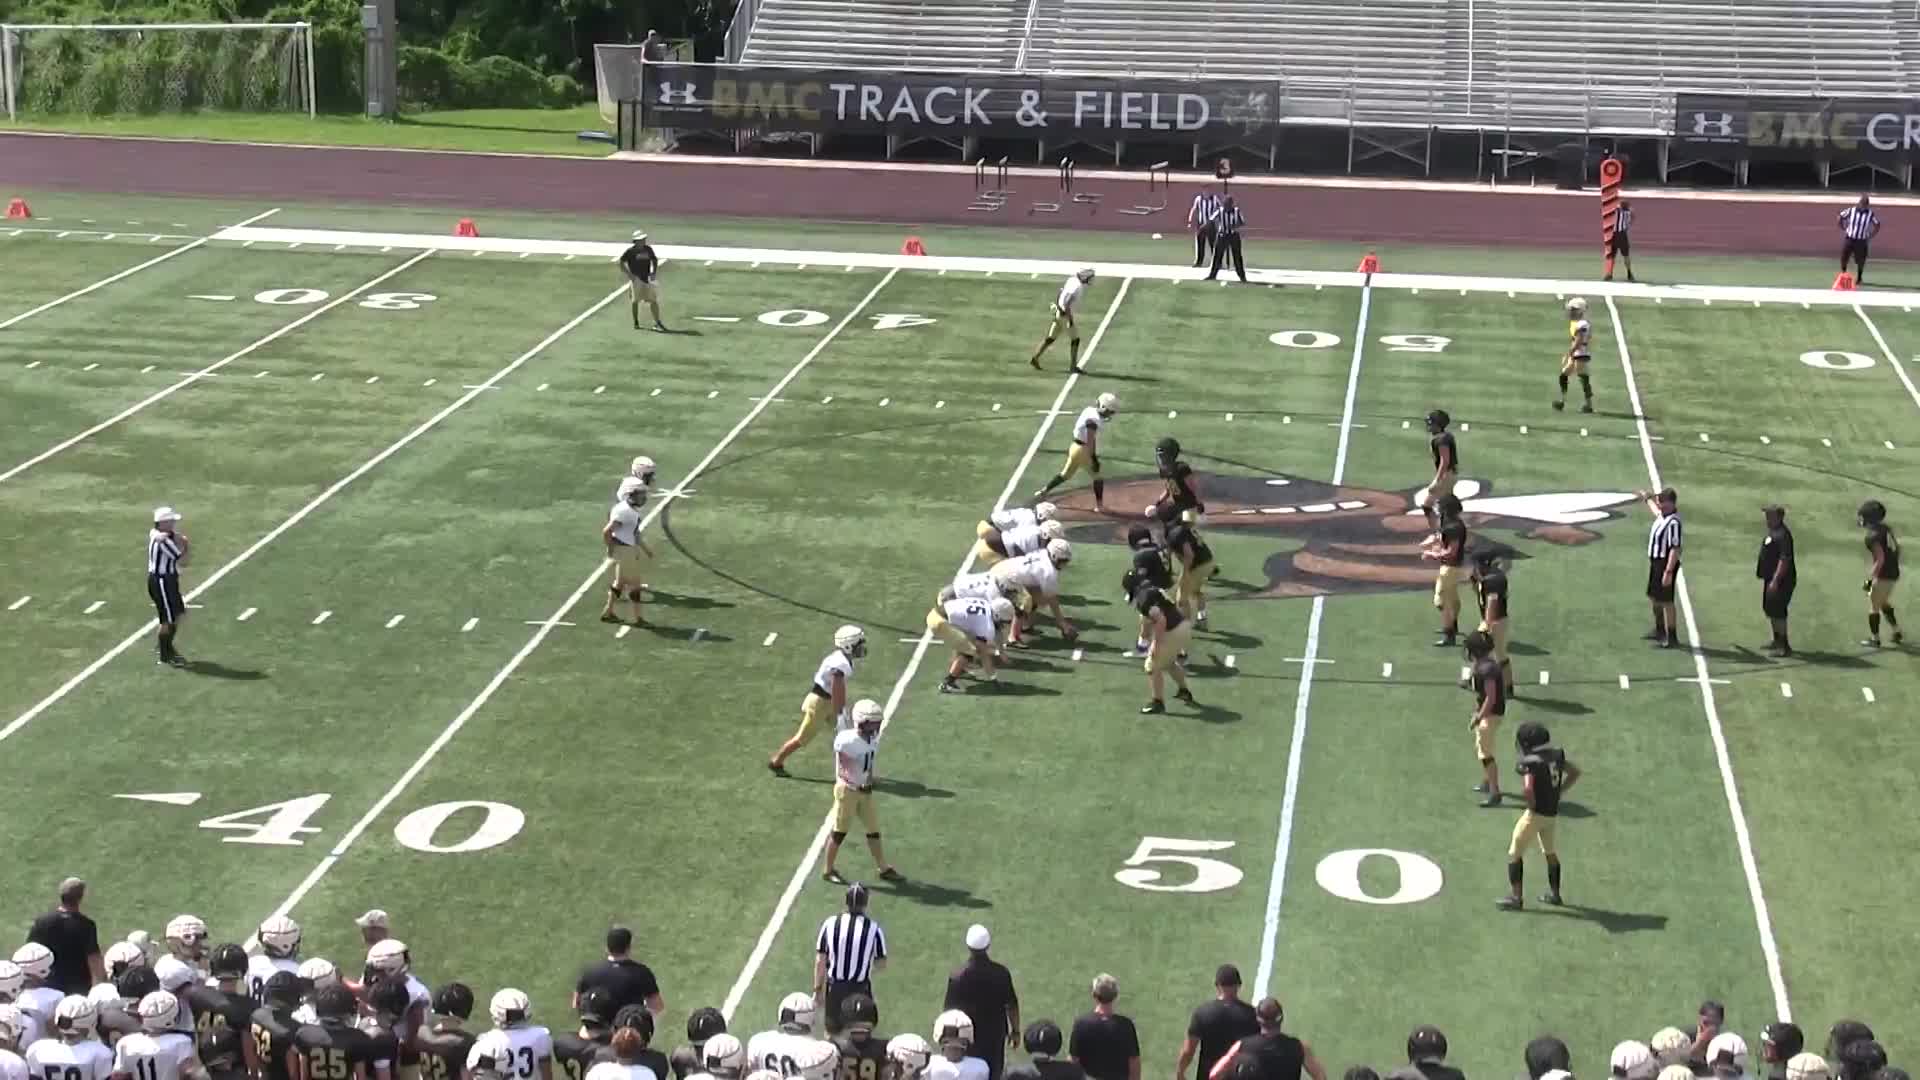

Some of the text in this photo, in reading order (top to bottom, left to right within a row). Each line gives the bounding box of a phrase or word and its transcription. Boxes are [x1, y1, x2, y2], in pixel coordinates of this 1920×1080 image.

[712, 79, 1210, 131] BMC TRACK & FIELD
[1747, 112, 1858, 150] BMC
[136, 1056, 157, 1080] 11
[309, 1047, 347, 1080] 25
